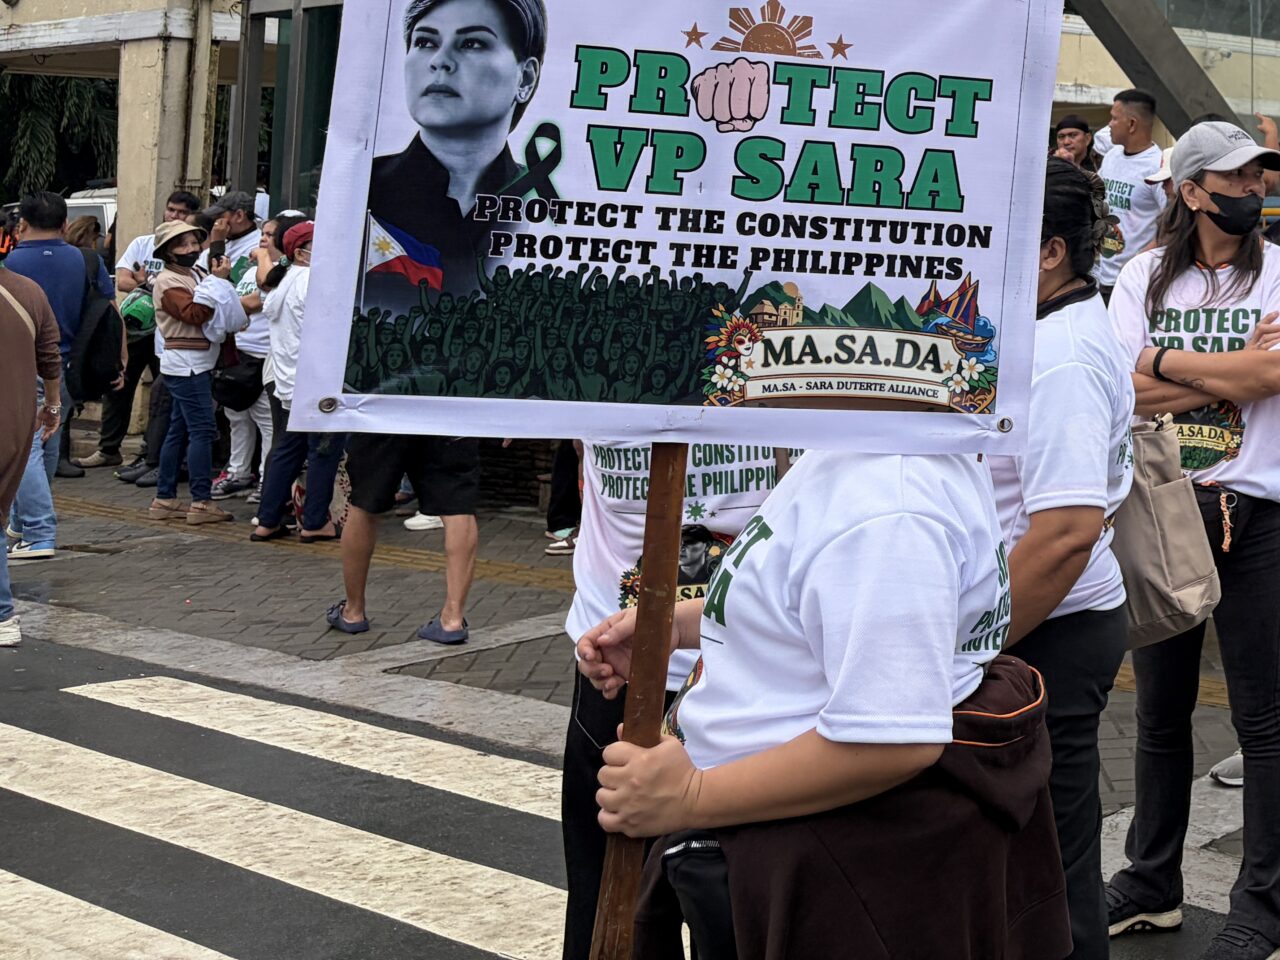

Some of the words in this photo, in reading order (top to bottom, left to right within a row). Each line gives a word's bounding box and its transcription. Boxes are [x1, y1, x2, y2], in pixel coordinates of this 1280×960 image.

[570, 44, 993, 138] PRTECT
[586, 124, 707, 196] VP
[731, 135, 964, 212] SARA
[1109, 193, 1131, 210] SARA
[473, 194, 643, 229] PROTECT
[655, 206, 725, 234] THE
[736, 212, 993, 248] CONSTITUTION
[489, 231, 657, 265] PROTECT
[669, 242, 739, 269] THE
[750, 246, 964, 280] PHILIPPINES
[761, 334, 944, 374] MA.SA.DA
[1192, 336, 1246, 353] SAR
[762, 381, 796, 394] MA.SA
[806, 380, 834, 392] SARA
[836, 381, 885, 393] DUTERTE
[888, 384, 939, 399] ALLIANCE
[1176, 425, 1226, 442] A.SA.DA
[601, 472, 650, 500] PROTEC
[702, 465, 778, 496] PHILIPPIN
